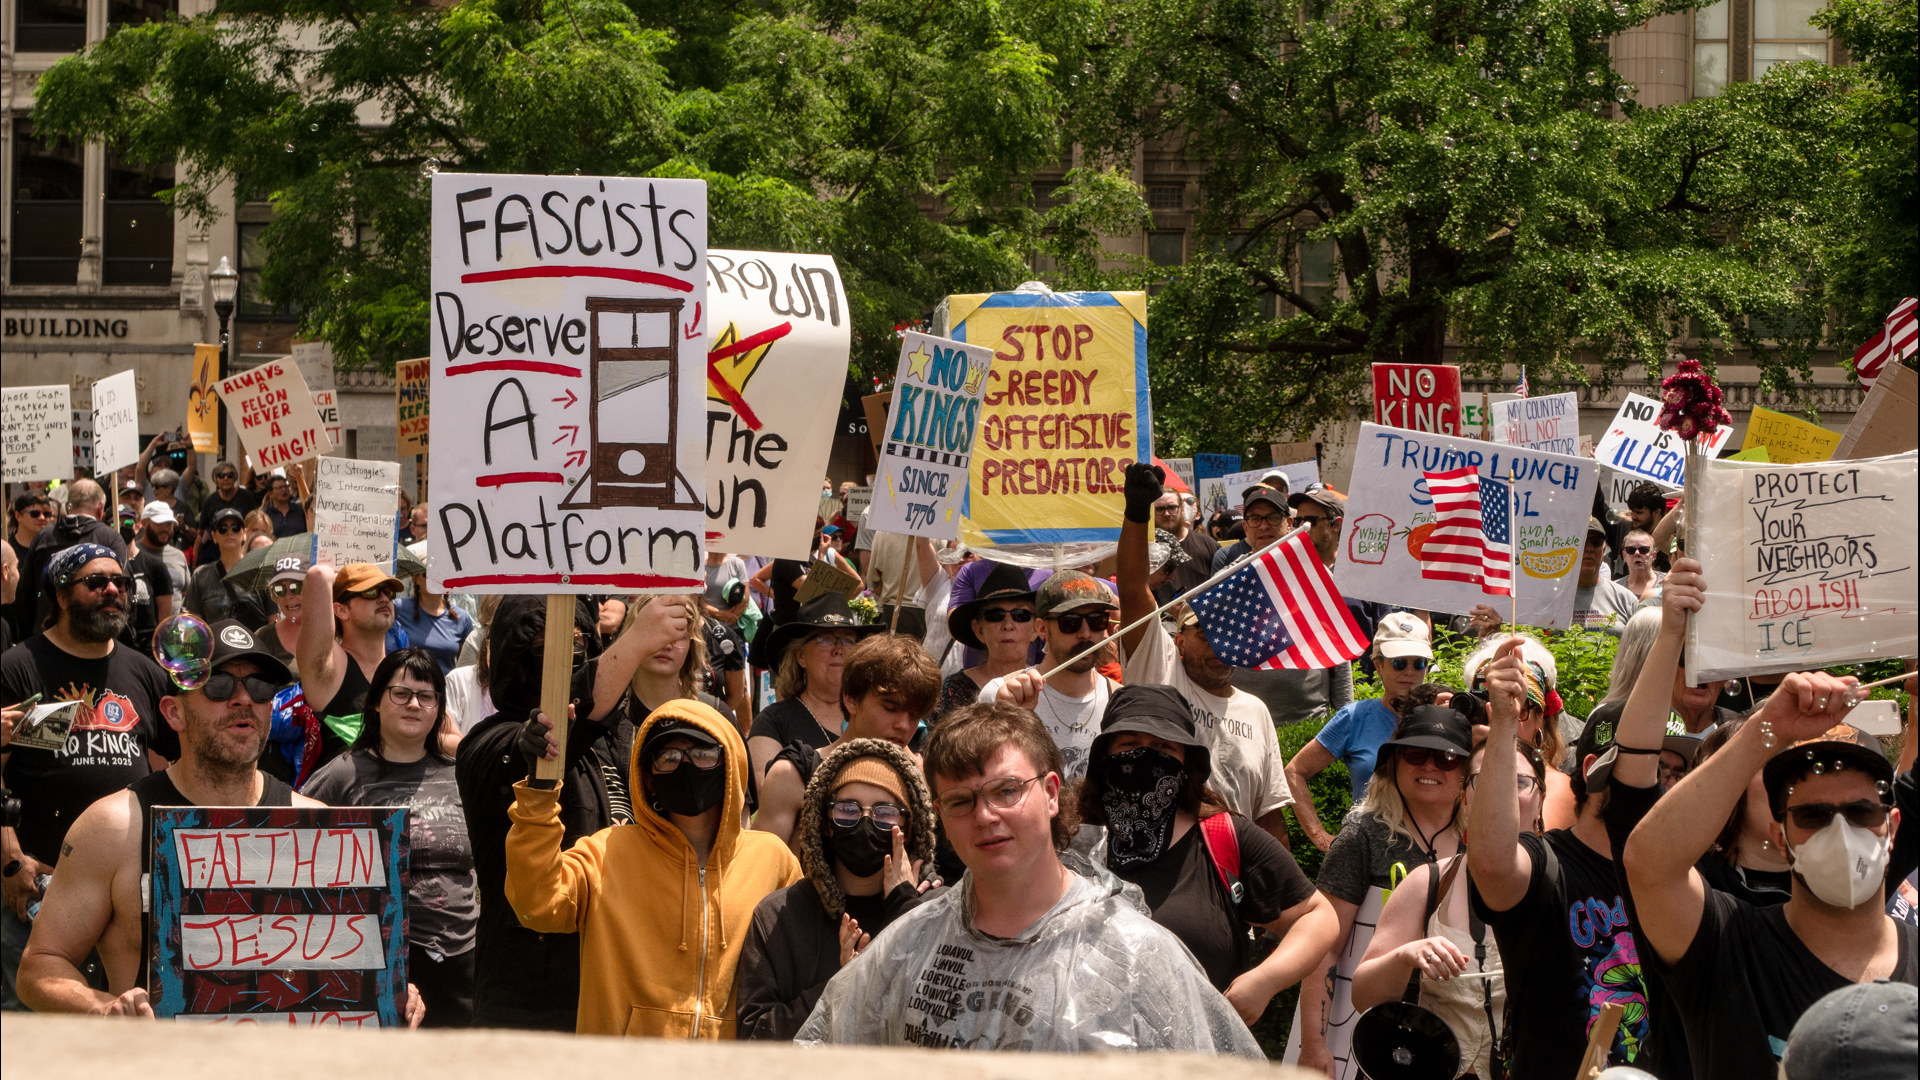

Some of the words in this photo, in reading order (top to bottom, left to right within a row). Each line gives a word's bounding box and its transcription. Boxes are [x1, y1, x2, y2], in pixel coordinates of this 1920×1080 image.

[4, 318, 128, 338] BUILDING
[436, 291, 586, 362] Deserve
[996, 324, 1095, 362] STOP
[223, 364, 284, 395] ALWAYS
[928, 344, 967, 392] NO
[258, 382, 270, 393] A
[984, 368, 1098, 406] GREEDY
[1388, 368, 1436, 399] NO
[240, 388, 288, 413] FELON
[1507, 402, 1522, 420] MY
[1526, 396, 1567, 420] COUNTRY
[1622, 400, 1655, 421] NO
[23, 411, 46, 422] MAY
[241, 402, 292, 430] NEVER
[271, 421, 282, 437] A
[484, 377, 537, 466] A
[891, 383, 979, 453] KINGS
[984, 411, 1133, 450] OFFENSIVE
[1380, 398, 1455, 437] KING
[1755, 415, 1790, 440] THIS
[1792, 426, 1809, 441] IS
[1811, 436, 1831, 446] NOT
[26, 433, 36, 442] OF
[45, 432, 51, 440] A
[1505, 421, 1531, 446] WILL
[1536, 417, 1560, 441] NOT
[1653, 432, 1672, 449] IS
[1750, 432, 1766, 446] THE
[1768, 438, 1811, 456] AMERICA
[16, 455, 26, 464] OF
[320, 459, 340, 476] Our
[345, 462, 385, 480] Struggles
[1376, 433, 1483, 471] TRUMP
[1490, 453, 1579, 491] LUNCH
[899, 466, 949, 497] SINCE
[981, 456, 1130, 495] PREDATORS
[1755, 469, 1860, 498] PROTECT
[317, 494, 365, 513] American
[905, 500, 938, 530] 1776
[439, 495, 700, 572] Platform
[1520, 525, 1542, 538] AND
[1545, 524, 1554, 537] A
[366, 542, 376, 551] on
[1757, 539, 1878, 572] NEIGHBORS
[276, 557, 301, 571] 502
[1754, 578, 1860, 616] ABOLISH
[1758, 618, 1812, 651] ICE
[1221, 717, 1253, 740] TORCH
[72, 756, 95, 766] JUNE
[97, 756, 110, 766] 14,
[112, 757, 133, 767] 2025
[181, 829, 322, 888] FAITH
[327, 829, 373, 886] IN
[184, 914, 366, 970] JESUS
